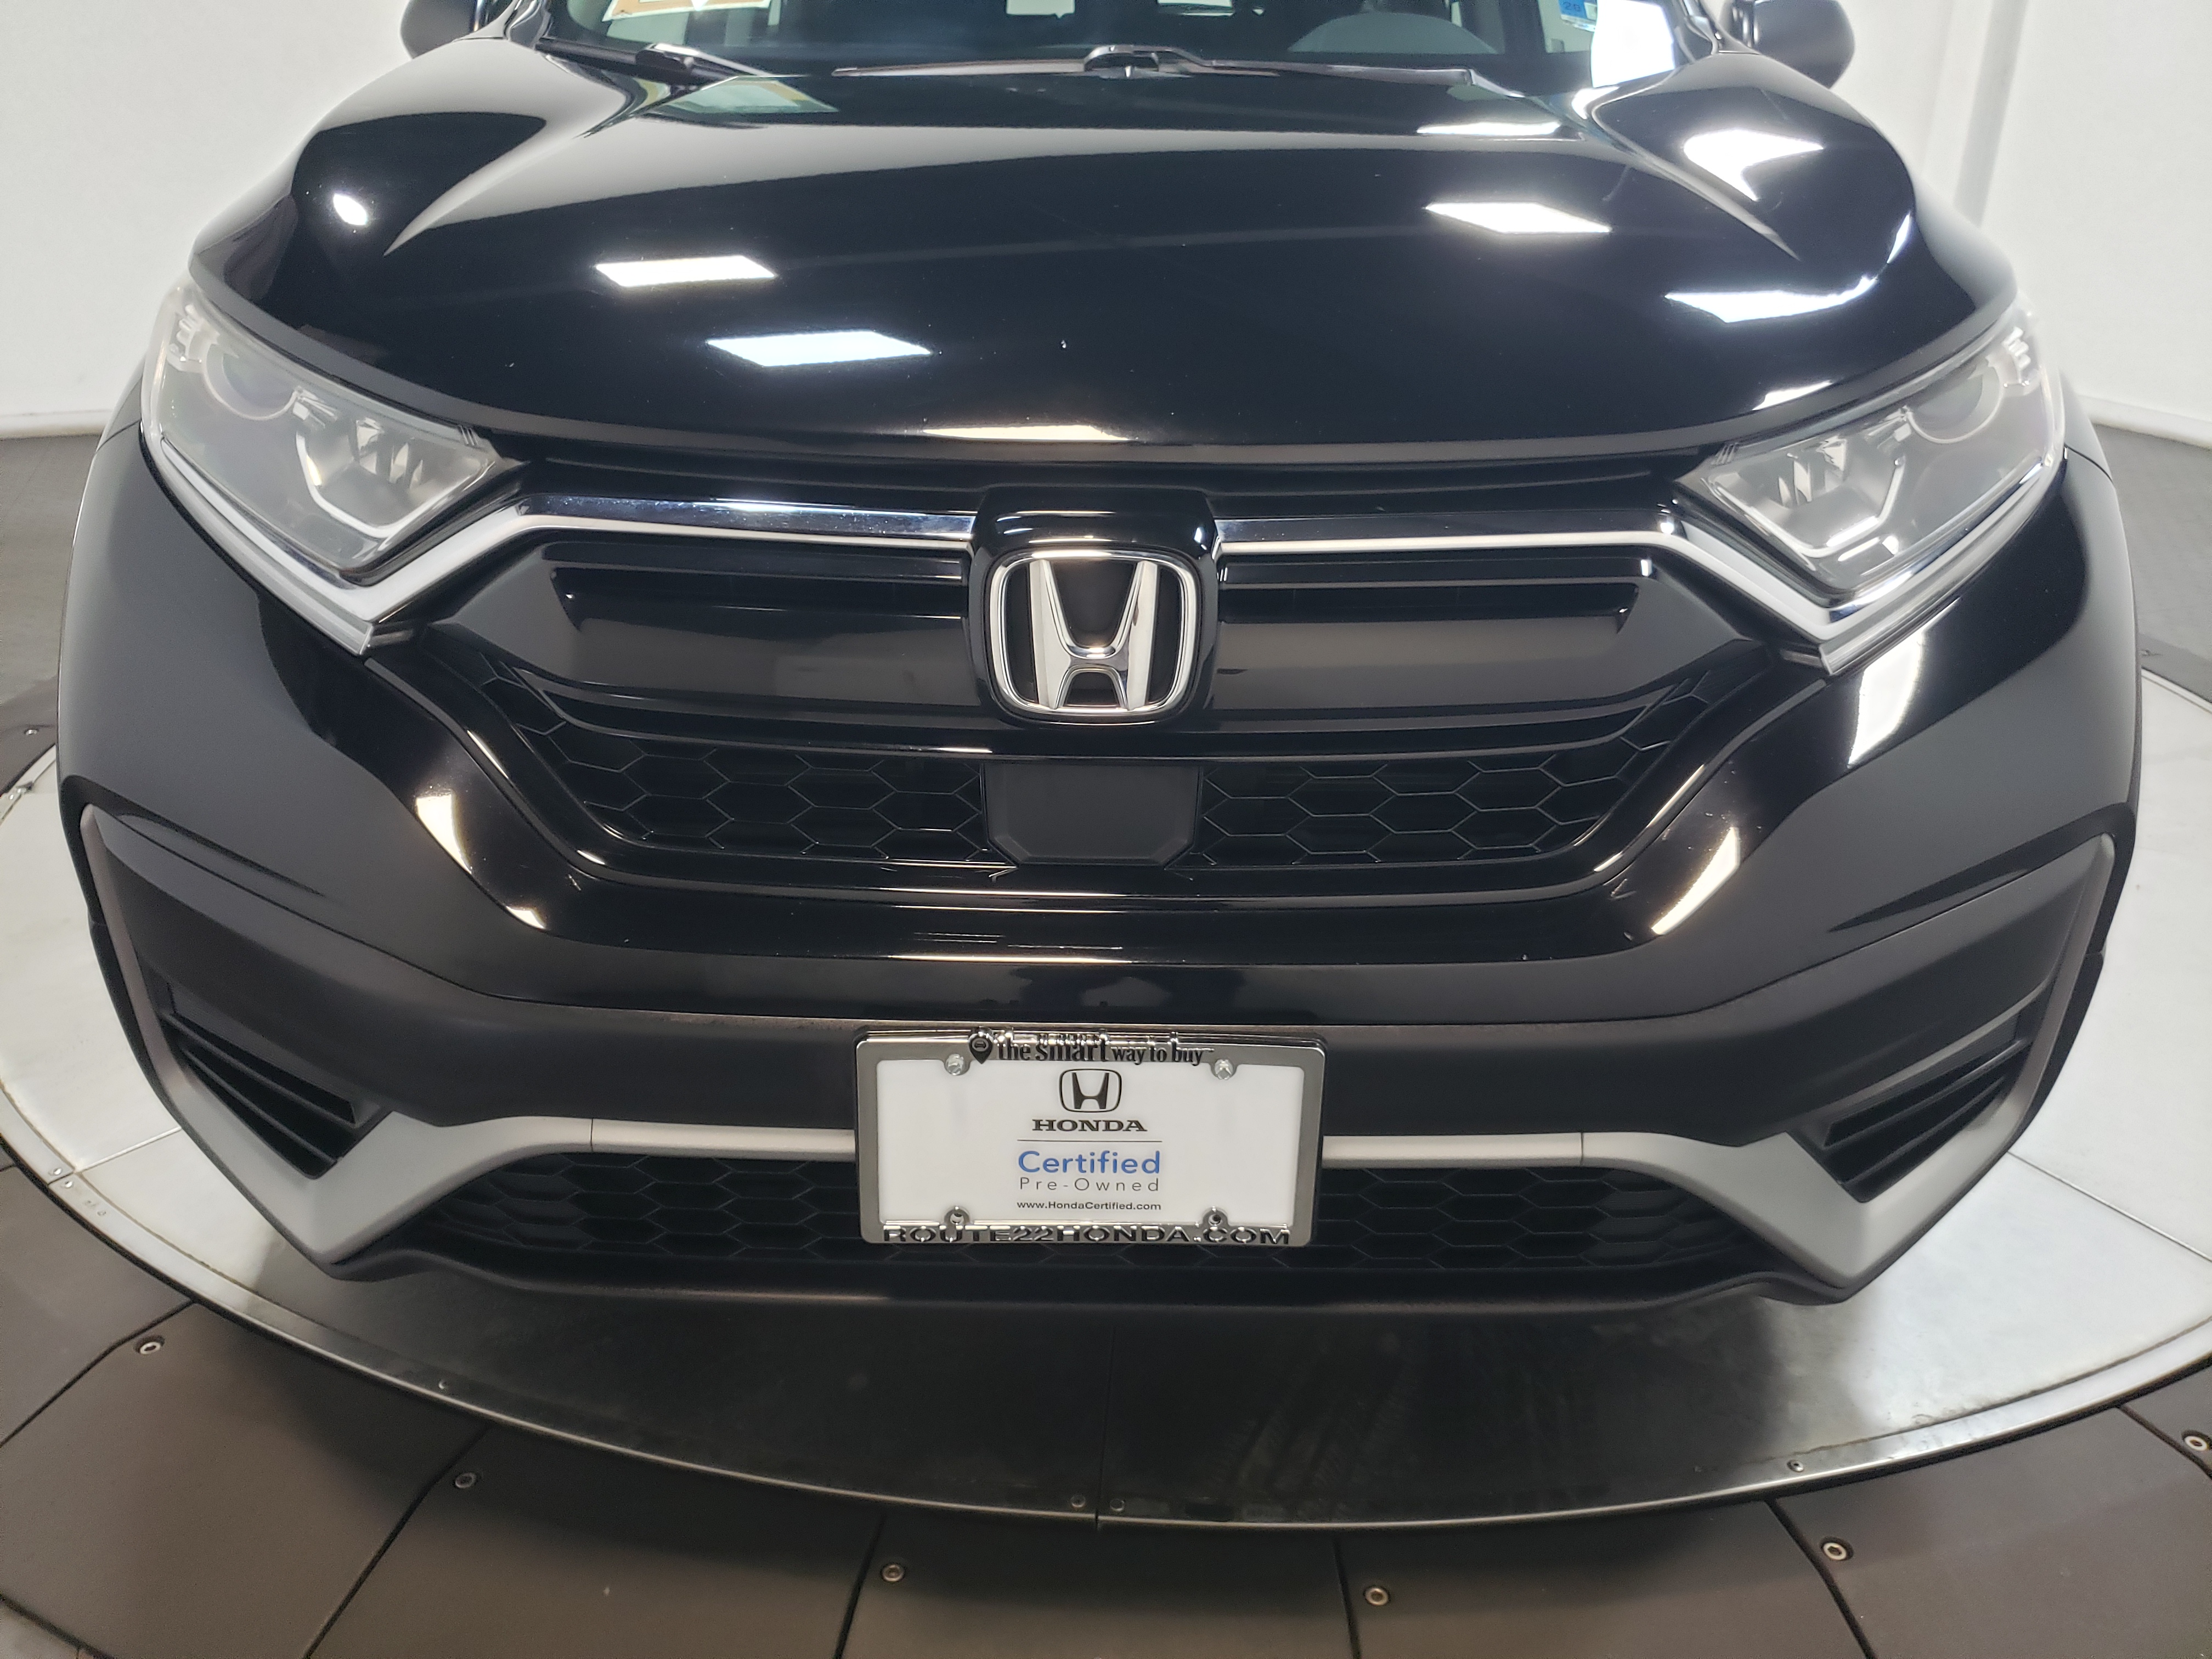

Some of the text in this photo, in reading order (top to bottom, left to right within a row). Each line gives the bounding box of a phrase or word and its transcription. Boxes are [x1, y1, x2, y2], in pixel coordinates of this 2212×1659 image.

[997, 1034, 1205, 1066] the smart way to buy
[1031, 1119, 1148, 1132] HONDA
[1018, 1150, 1160, 1173] Certified
[1019, 1177, 1159, 1191] Pre-Owned
[1017, 1201, 1162, 1210] www.HondaCertified.com
[883, 1224, 1290, 1245] ROUTE22HONDA.COM
